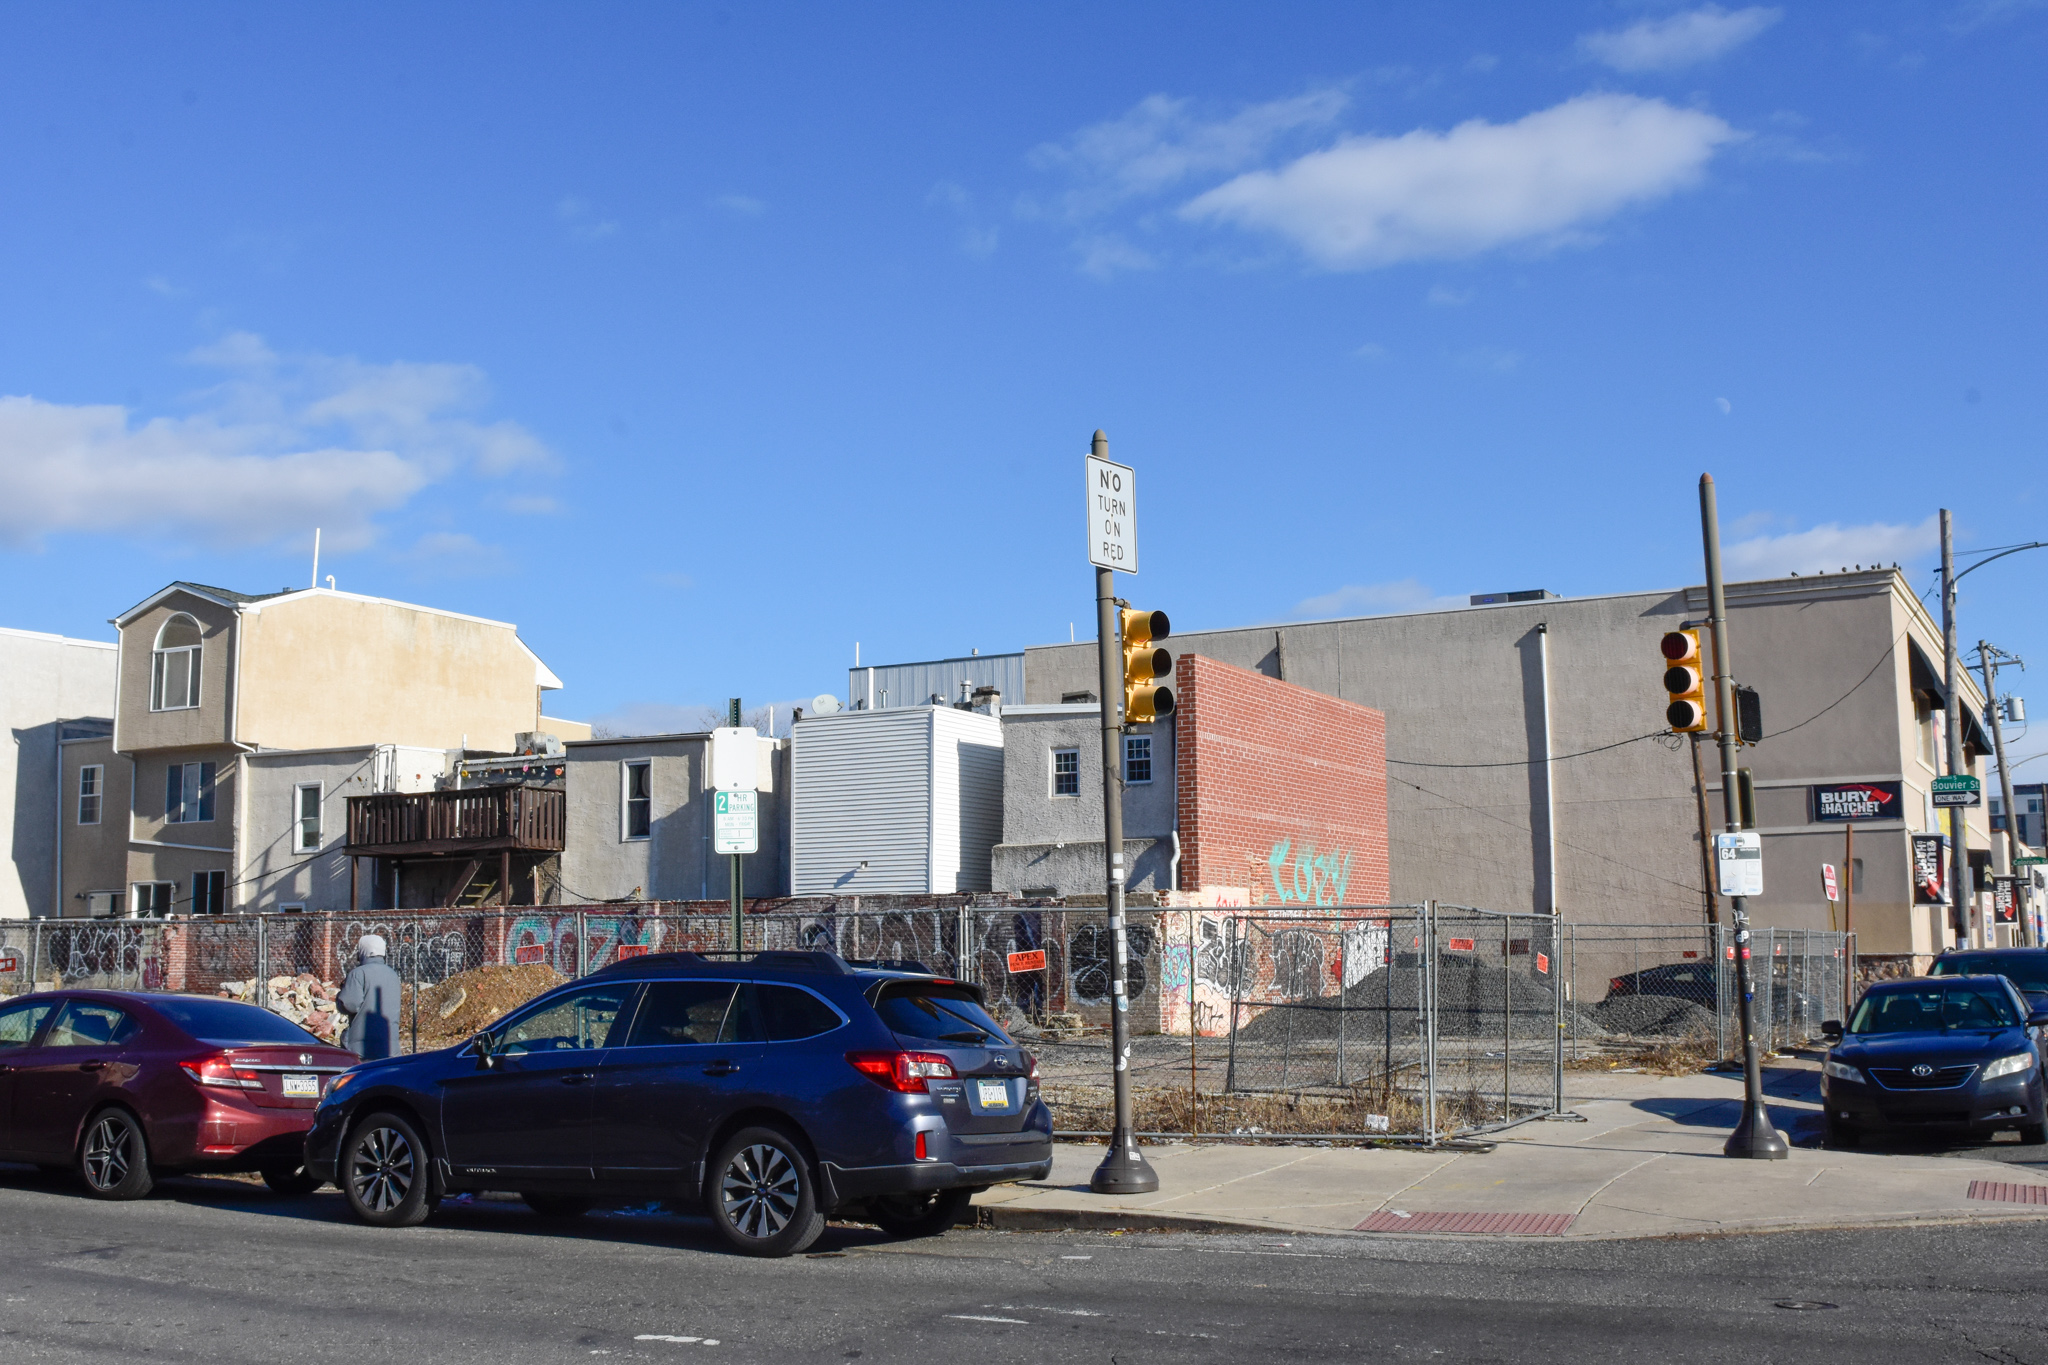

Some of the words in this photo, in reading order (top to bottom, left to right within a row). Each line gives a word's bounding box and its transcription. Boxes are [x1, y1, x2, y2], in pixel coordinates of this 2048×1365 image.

[1100, 469, 1121, 492] NO
[1098, 494, 1126, 517] TURN
[1105, 519, 1120, 537] ON
[1103, 541, 1123, 561] RED
[1932, 781, 1967, 790] Bouvier
[1970, 780, 1980, 789] St
[718, 795, 726, 811] 2
[737, 794, 747, 802] HR
[1821, 791, 1871, 803] BURY
[1825, 801, 1880, 814] HATCHET
[1721, 848, 1736, 860] 64
[1926, 840, 1938, 882] BURY
[1016, 952, 1038, 961] APEX
